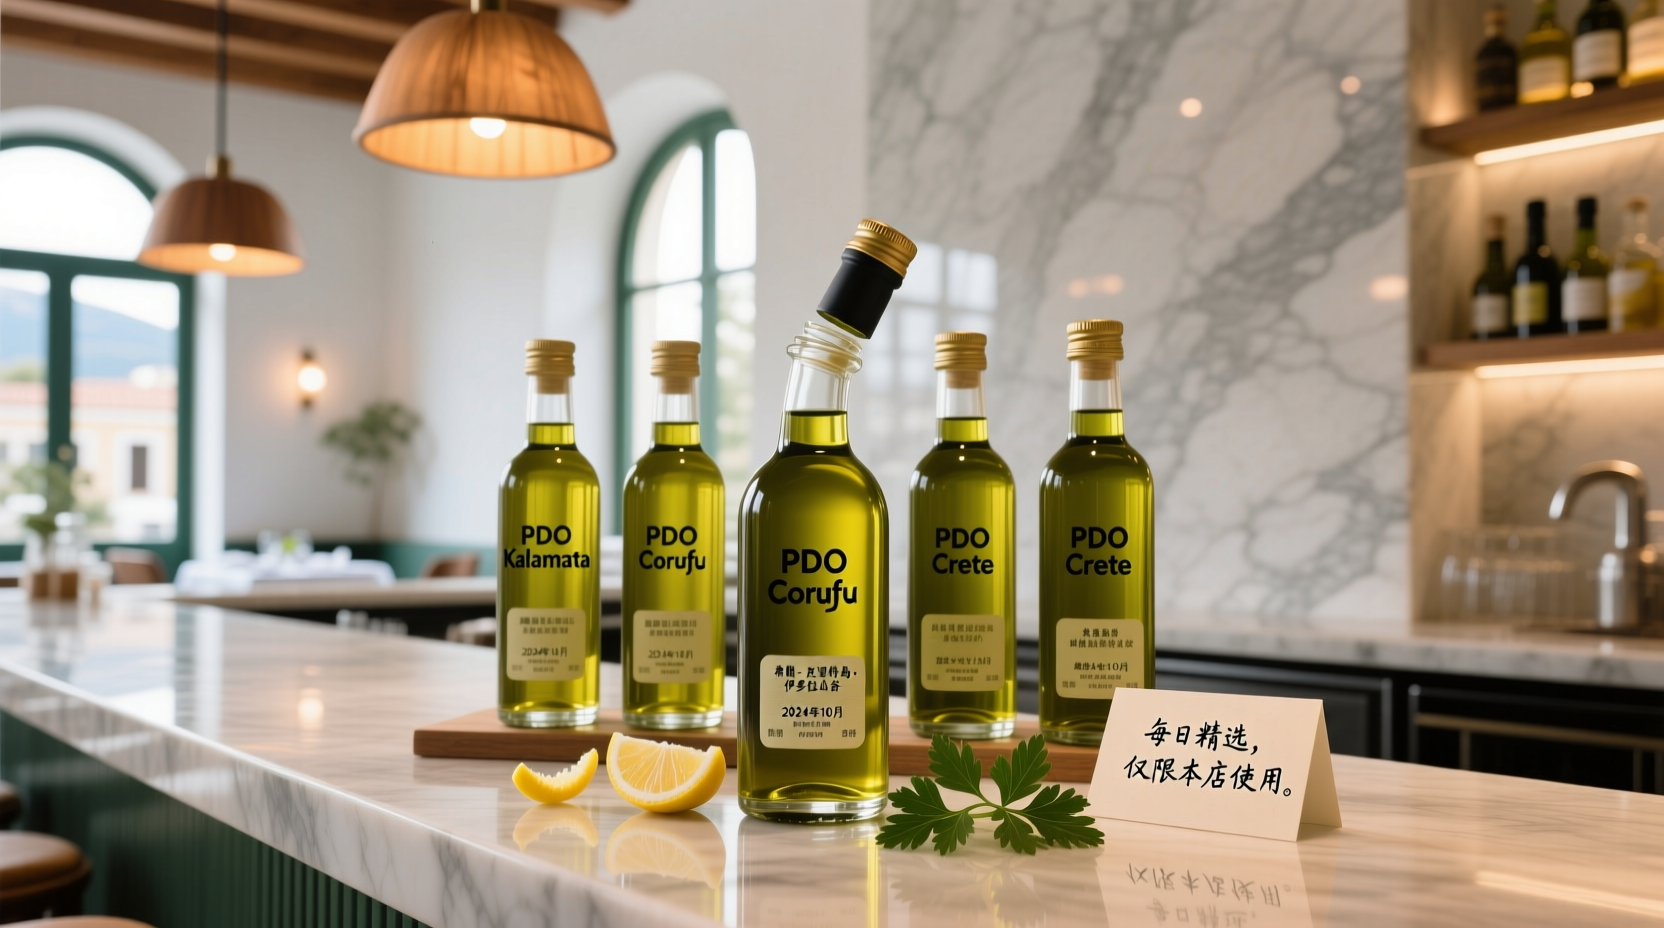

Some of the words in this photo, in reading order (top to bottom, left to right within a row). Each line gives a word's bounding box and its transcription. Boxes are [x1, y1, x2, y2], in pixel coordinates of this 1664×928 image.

[521, 525, 572, 545] PDO
[646, 525, 698, 546] PDO
[935, 527, 990, 549] PDO
[1071, 526, 1129, 549] PDO
[503, 548, 590, 569] Kalamata
[638, 549, 706, 576] Corufu
[781, 548, 847, 574] PDO
[931, 552, 994, 575] Crete
[1065, 552, 1132, 576] Crete
[767, 578, 857, 613] Corufu
[781, 705, 843, 719] 2024年10月
[1144, 717, 1258, 755] 每日精选，
[1123, 755, 1292, 797] 仅限本店使用。
